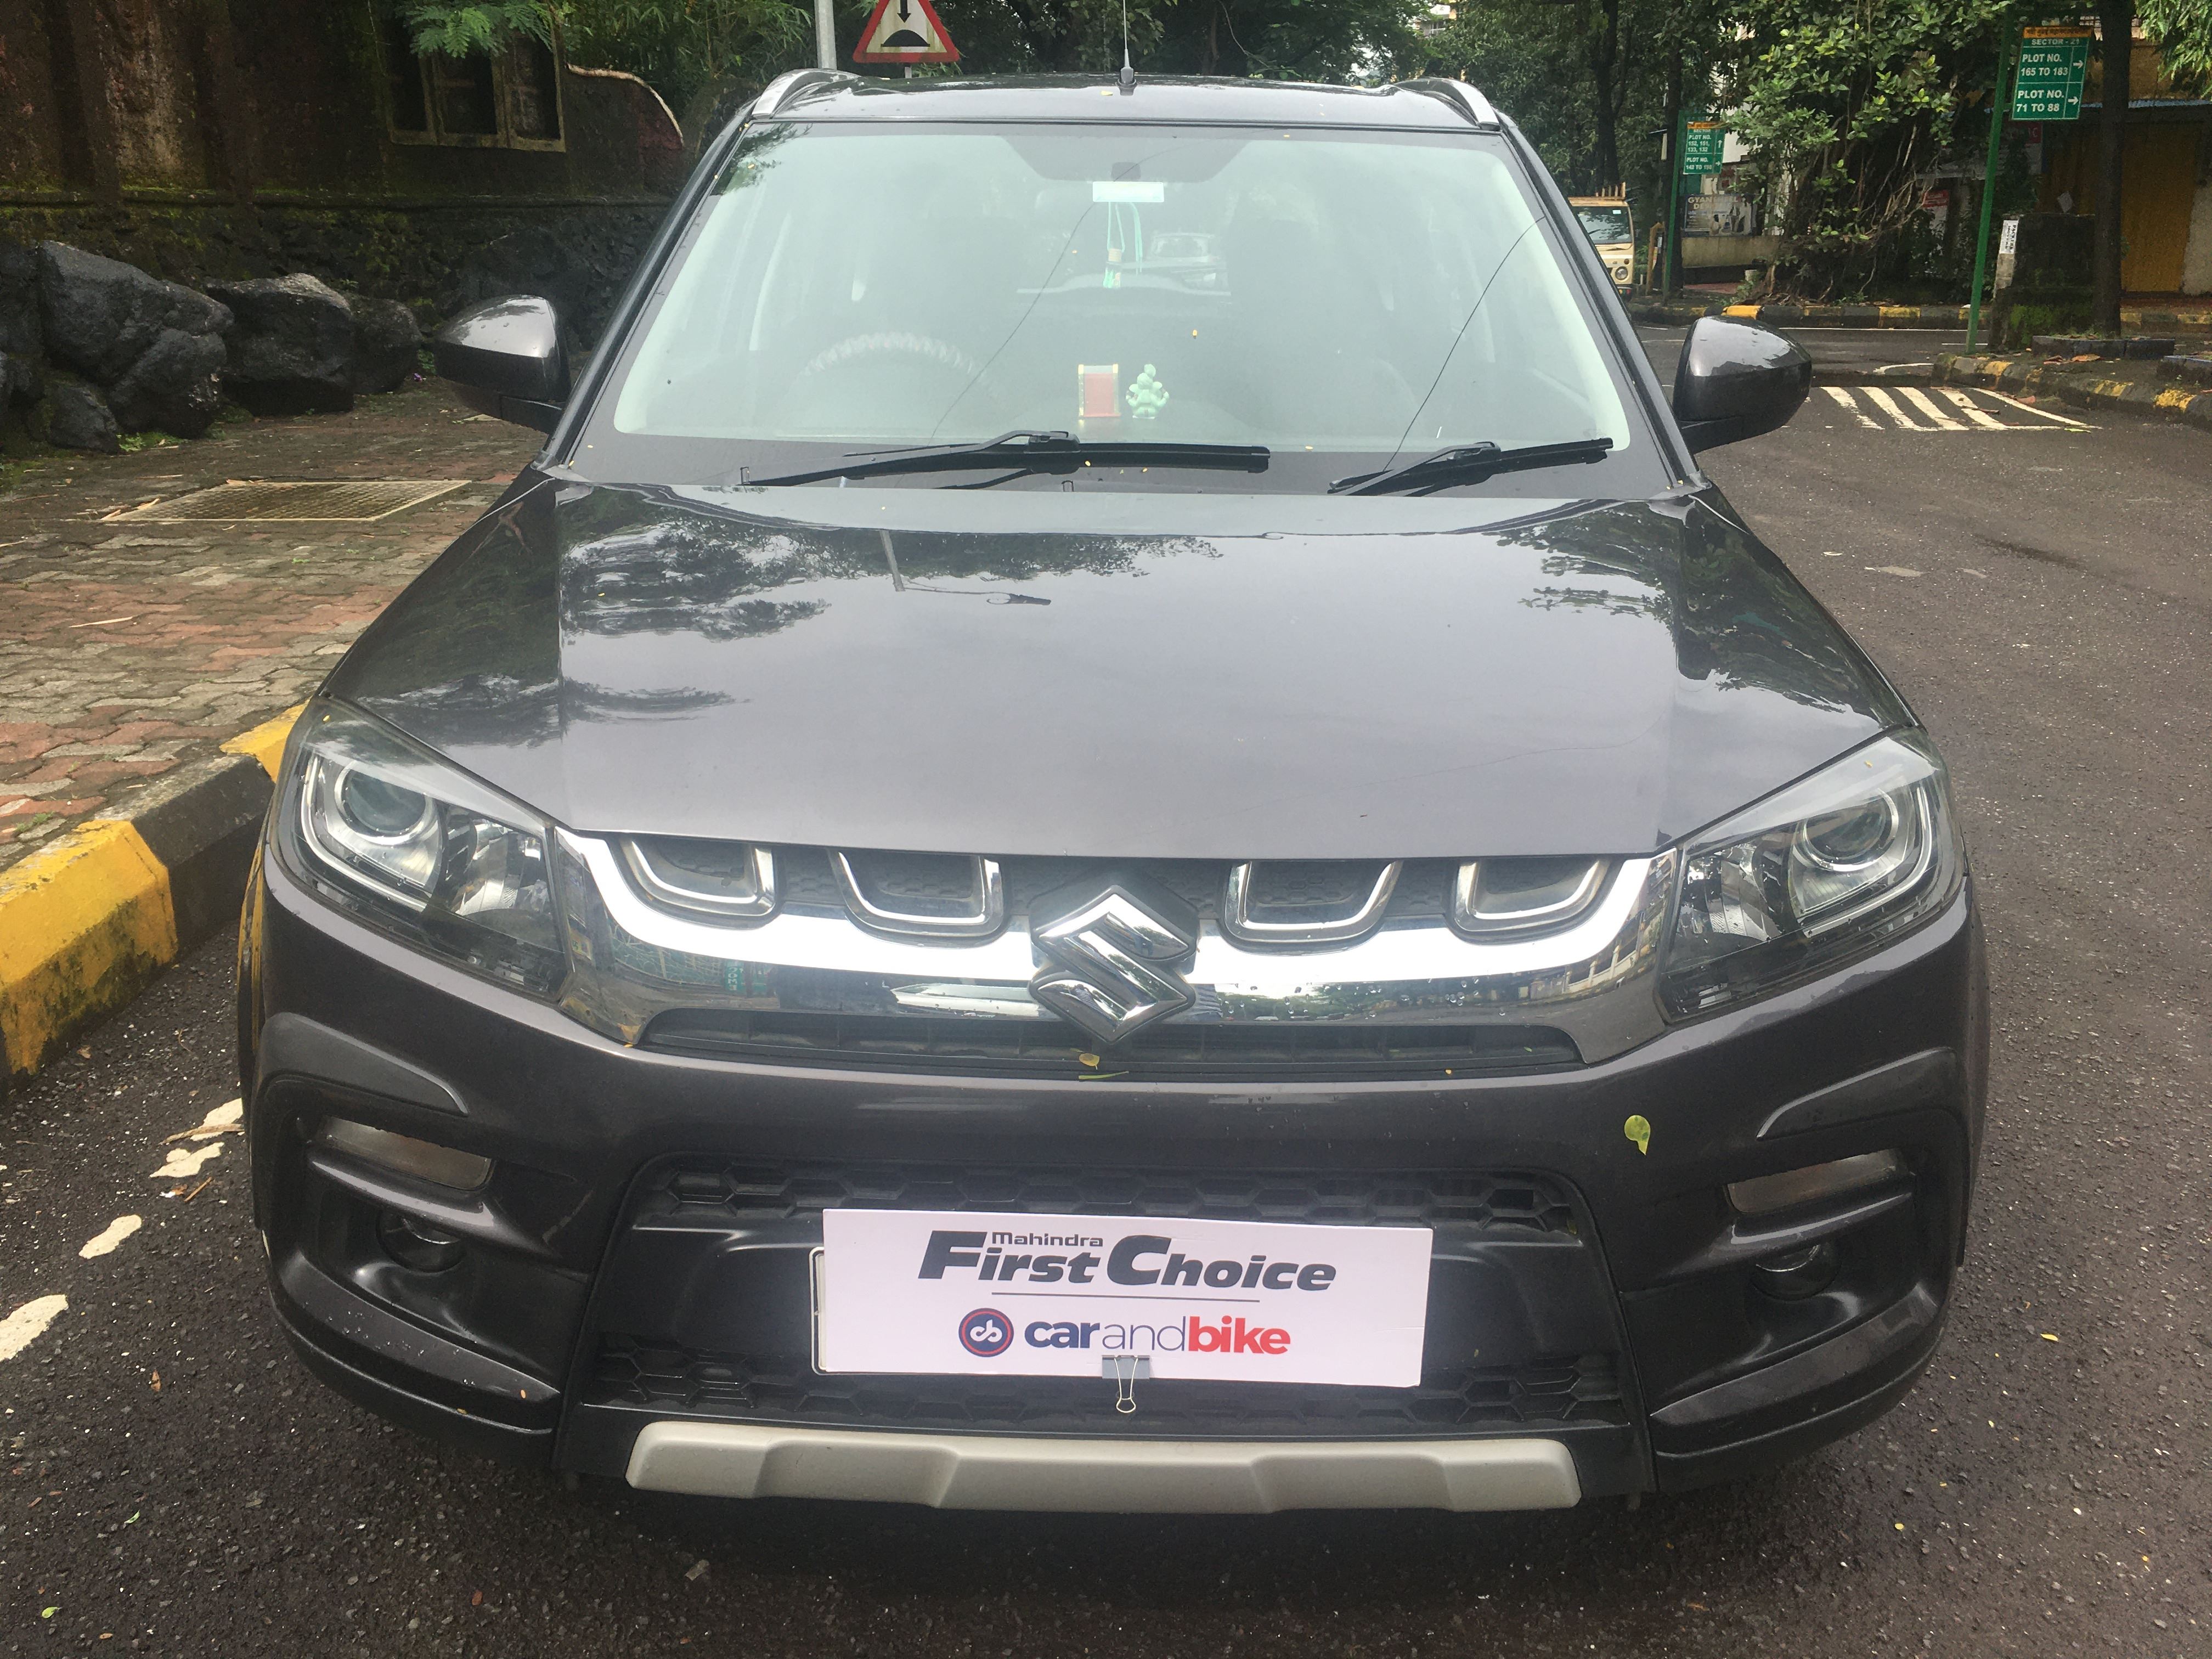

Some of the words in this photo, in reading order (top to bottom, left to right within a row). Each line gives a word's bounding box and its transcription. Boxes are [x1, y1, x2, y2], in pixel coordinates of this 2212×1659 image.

[2022, 54, 2045, 62] PLOT
[2047, 54, 2062, 62] NO.
[2021, 67, 2036, 76] 165
[2053, 67, 2068, 76] 183
[2018, 90, 2044, 99] PLOT
[2047, 90, 2064, 98] NO.
[991, 1232, 1103, 1247] Mahindra
[917, 1229, 1101, 1284] First
[1107, 1234, 1337, 1291] Choice
[1024, 1314, 1291, 1355] carandbike
